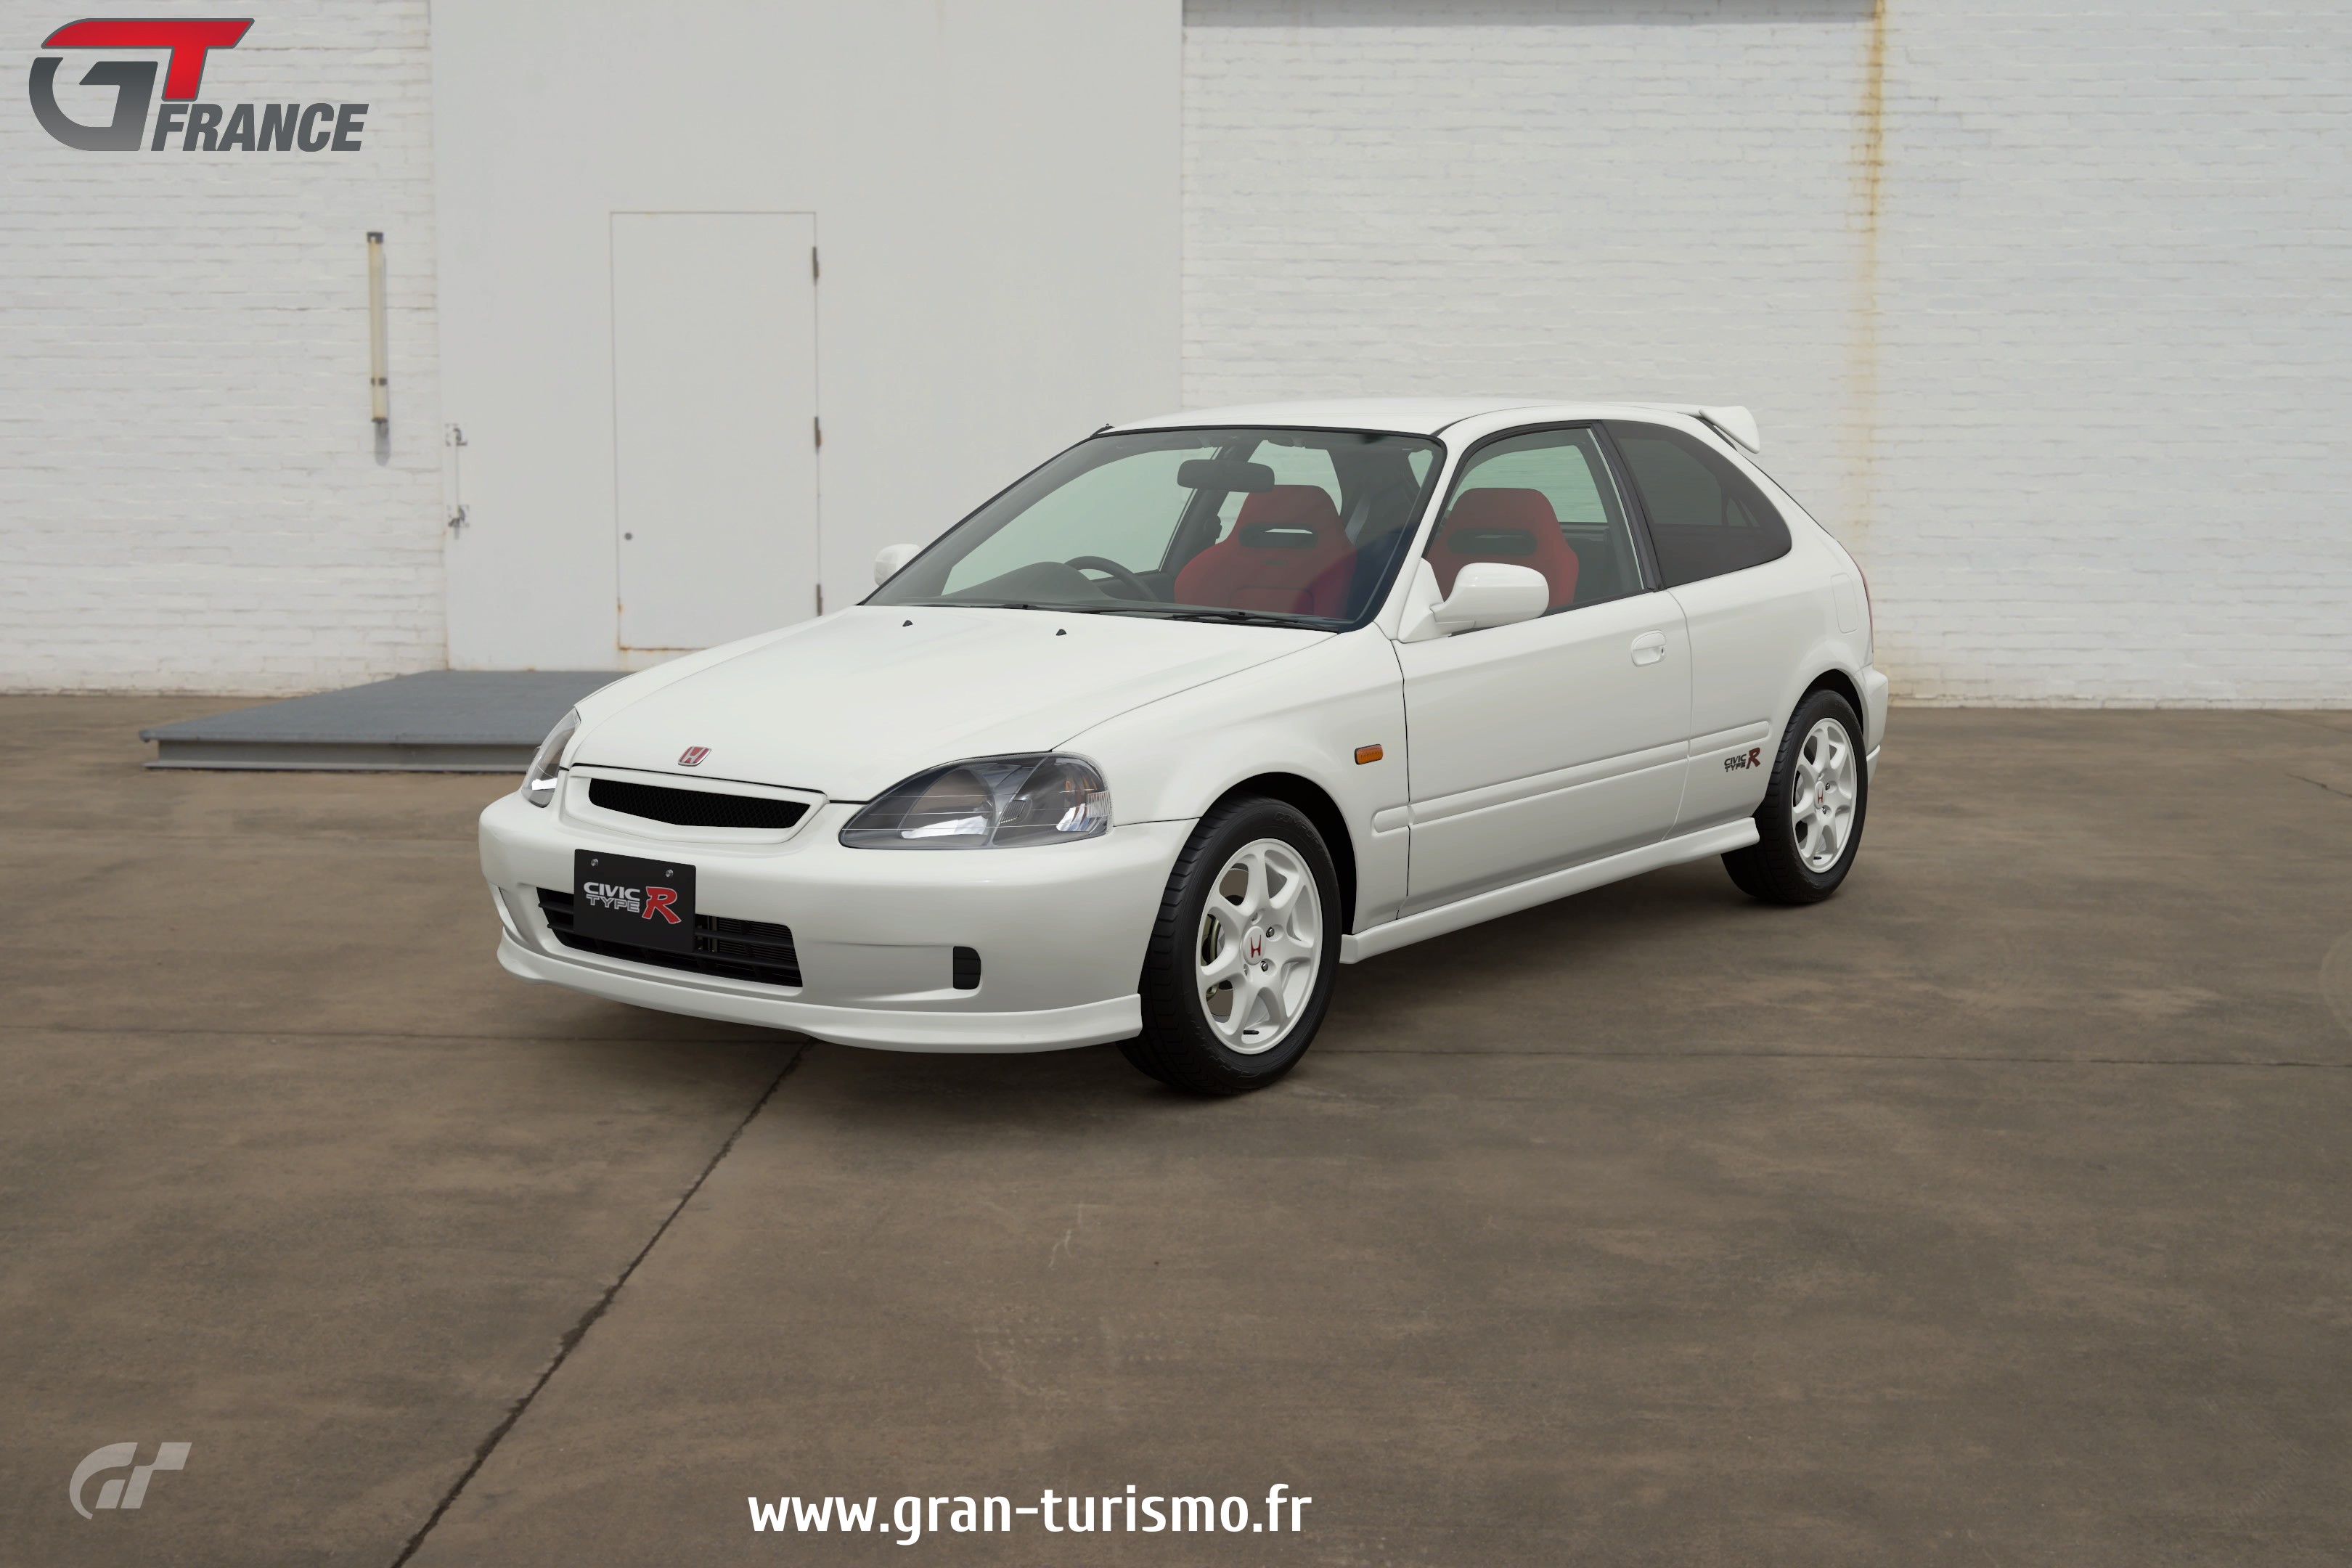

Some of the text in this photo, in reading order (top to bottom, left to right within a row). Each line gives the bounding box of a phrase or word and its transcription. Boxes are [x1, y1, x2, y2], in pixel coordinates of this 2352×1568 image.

[1724, 754, 1747, 767] CIVIC
[1725, 747, 1760, 772] TYPE R
[583, 881, 640, 902] CIVIC
[586, 886, 682, 924] TYPE R
